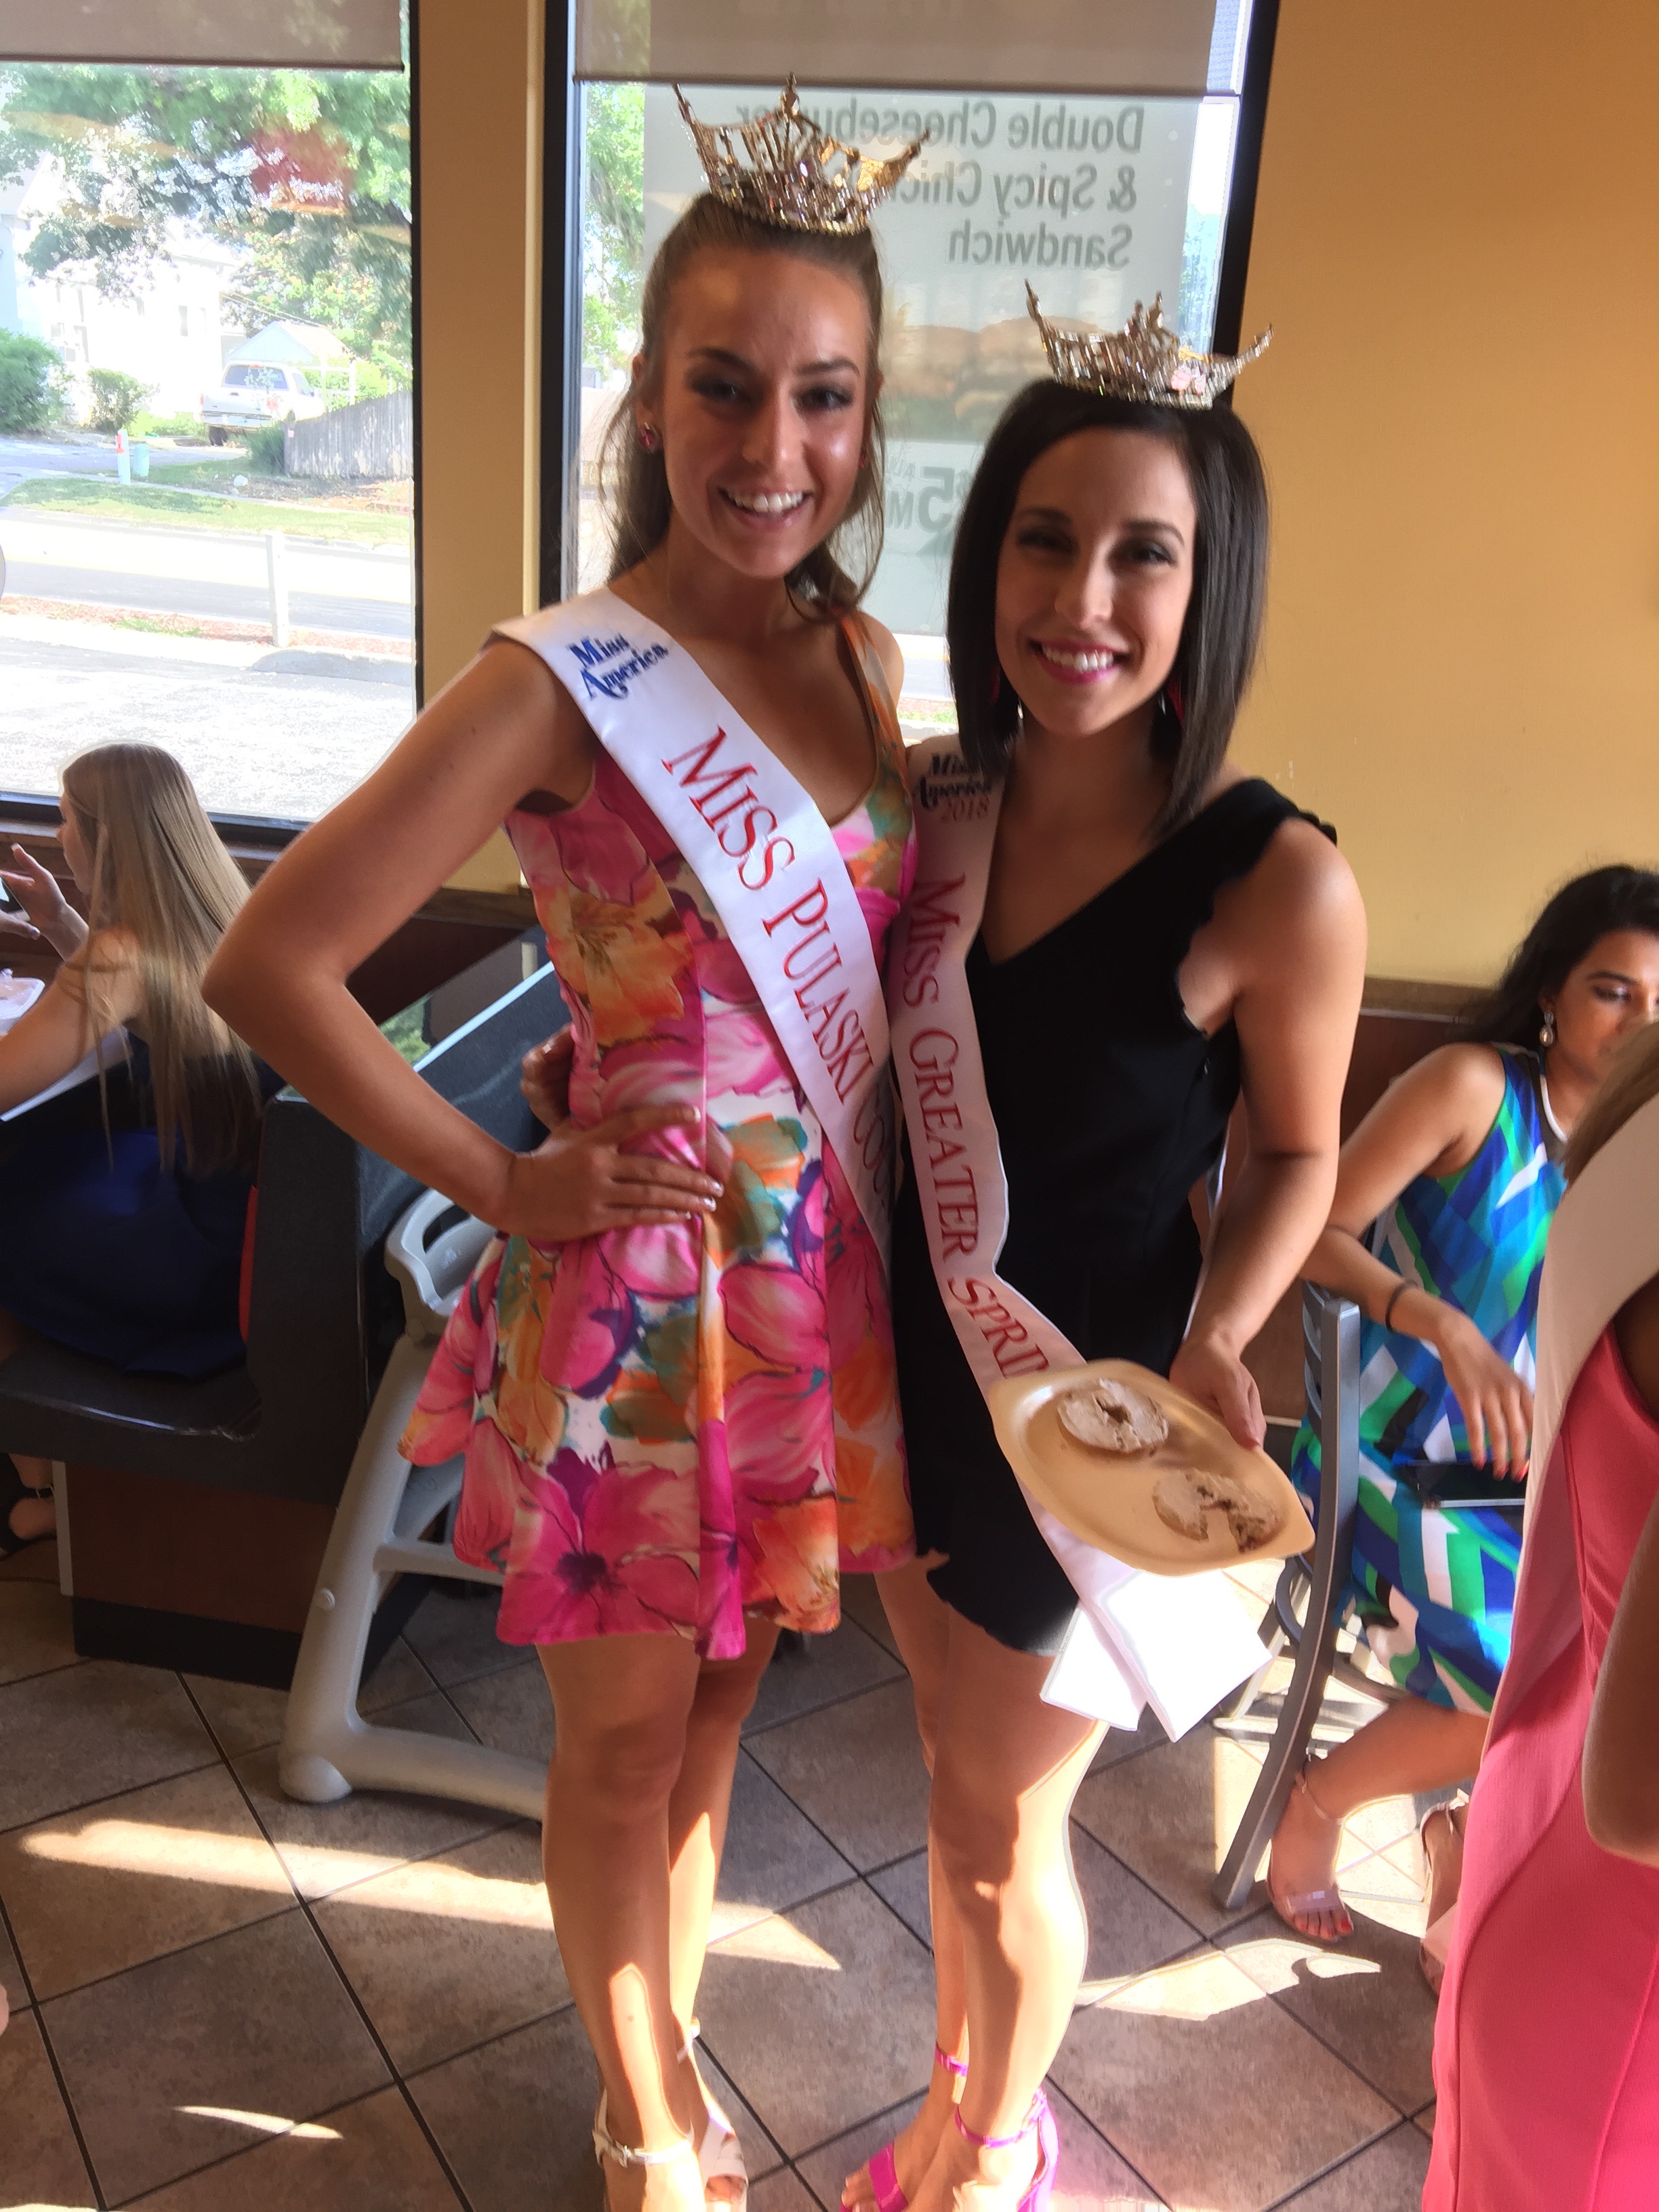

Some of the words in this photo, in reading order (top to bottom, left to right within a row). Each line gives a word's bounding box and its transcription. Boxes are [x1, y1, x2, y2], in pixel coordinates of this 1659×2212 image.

[567, 633, 631, 669] Miss
[579, 642, 670, 701] America
[661, 723, 796, 891] MISS
[761, 876, 874, 1106] PULASKI
[903, 872, 966, 1009] MISS
[909, 1027, 979, 1264] GREATER
